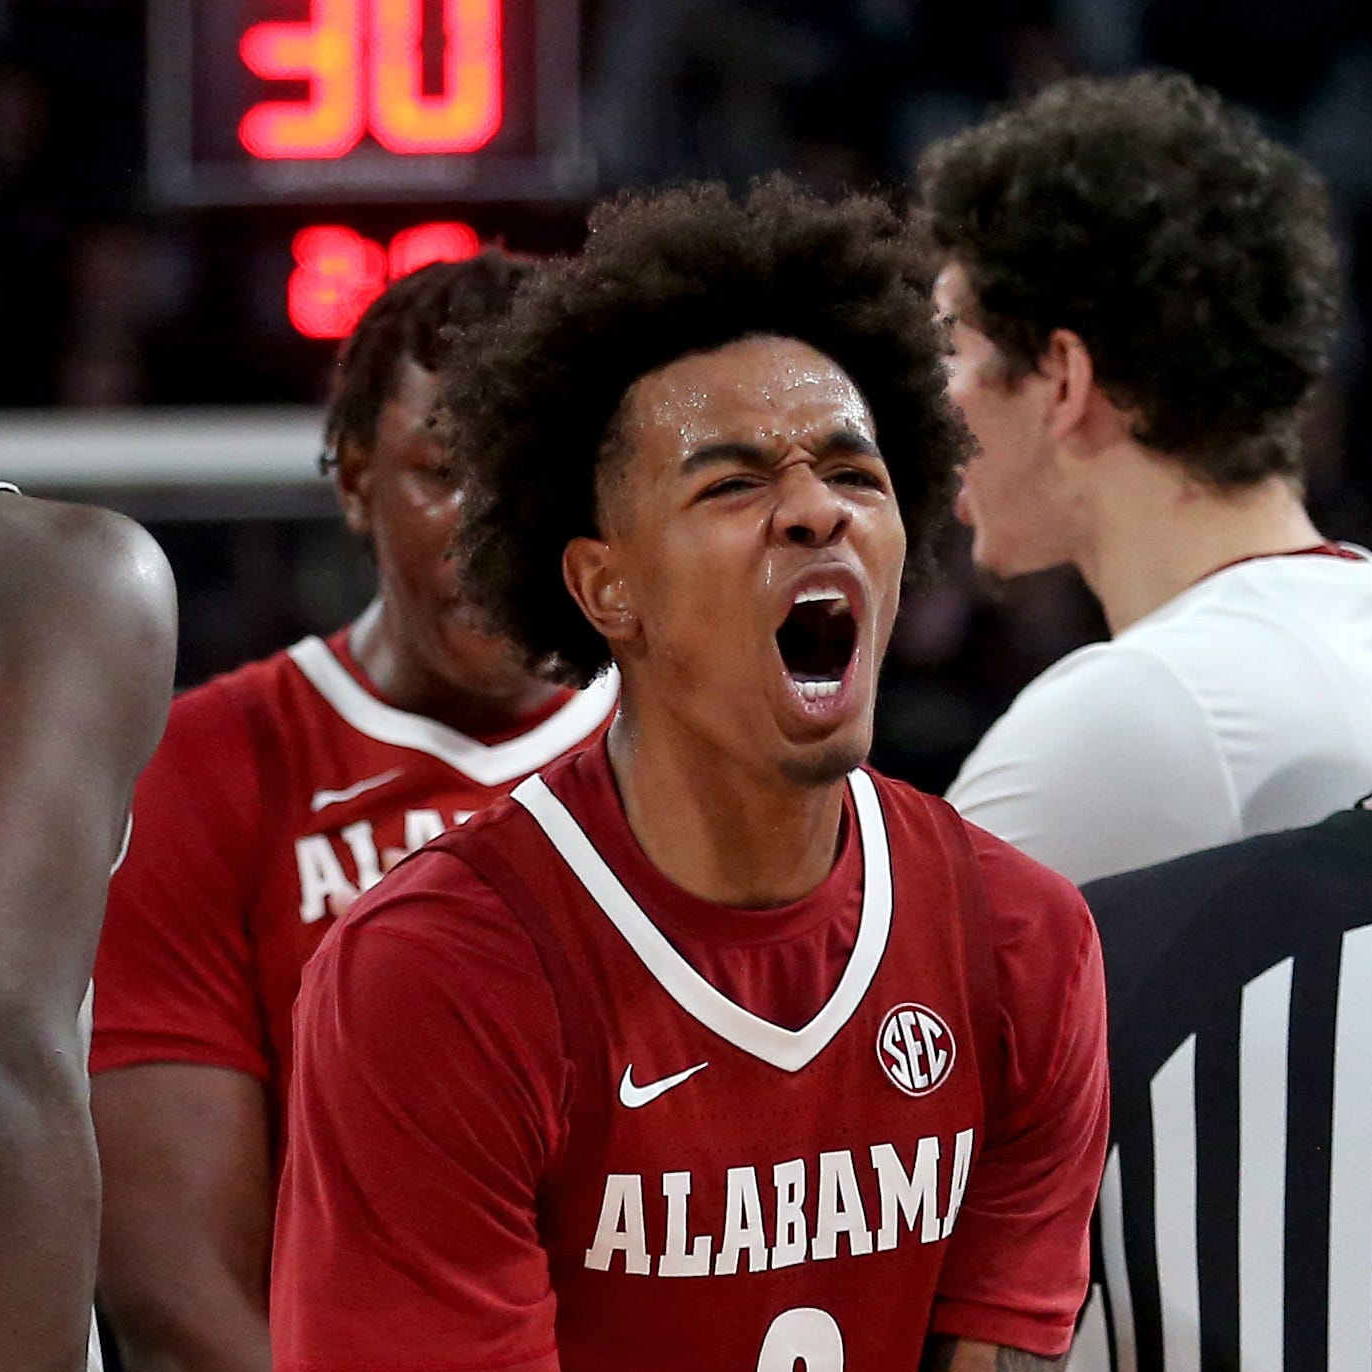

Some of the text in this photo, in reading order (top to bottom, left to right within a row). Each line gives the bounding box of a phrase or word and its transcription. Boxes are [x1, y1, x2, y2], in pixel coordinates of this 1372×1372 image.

[238, 0, 504, 160] 30
[883, 1010, 948, 1090] SEC
[584, 1128, 974, 1277] ALABAMA
